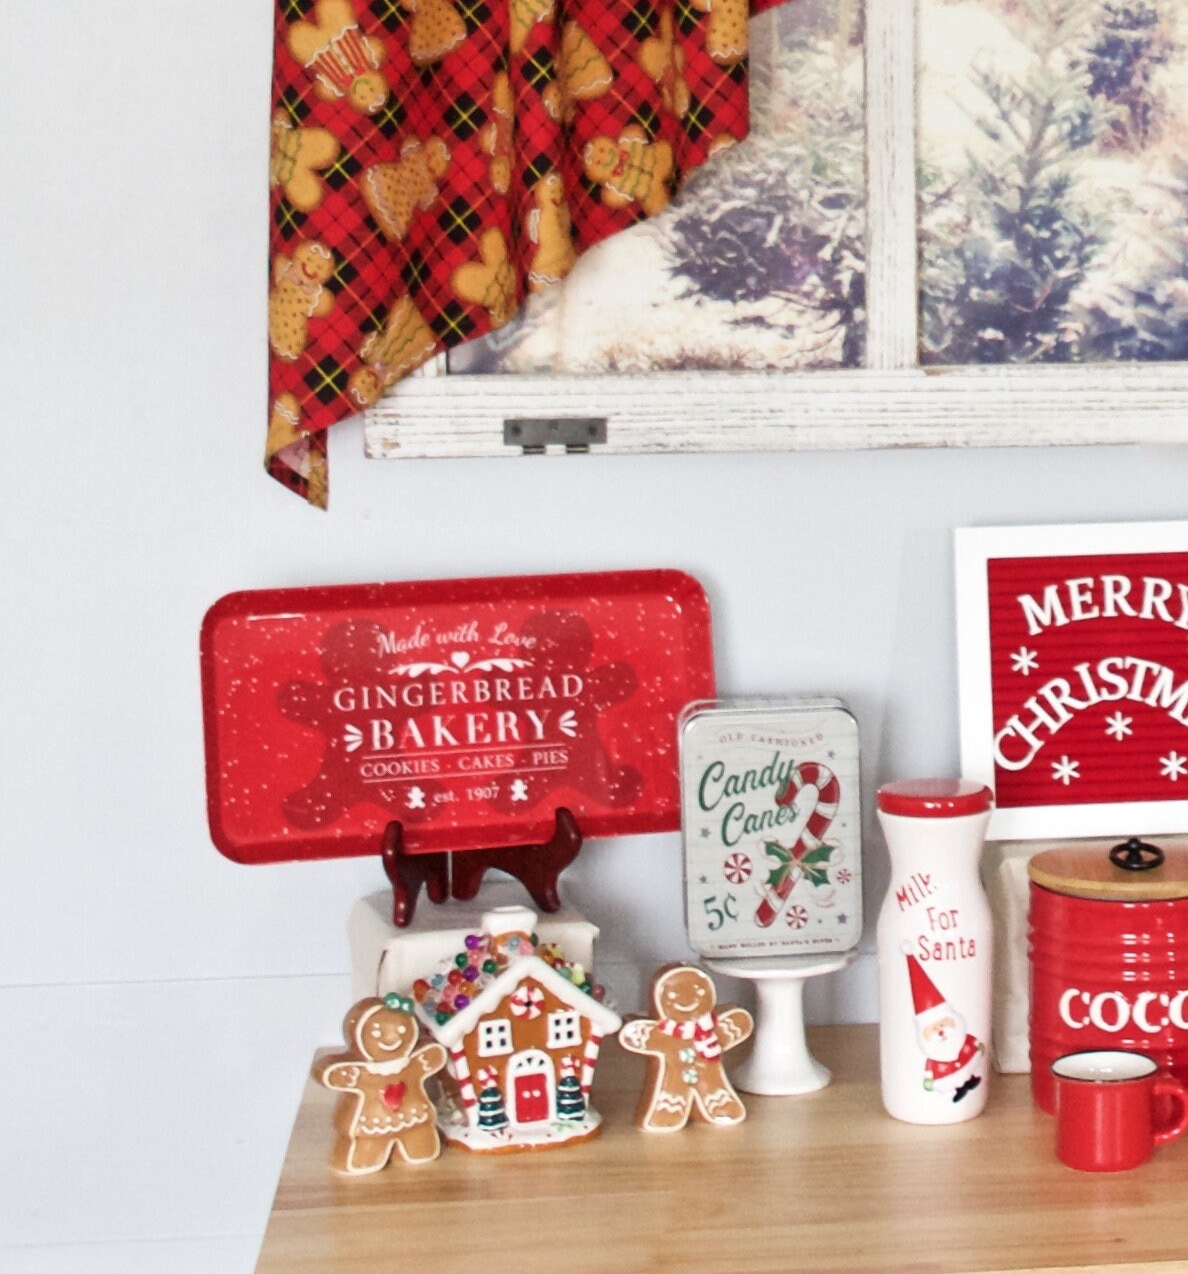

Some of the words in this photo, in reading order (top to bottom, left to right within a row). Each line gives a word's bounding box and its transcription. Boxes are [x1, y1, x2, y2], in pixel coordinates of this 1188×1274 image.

[377, 625, 429, 658] Made
[436, 620, 479, 646] with
[490, 621, 538, 650] Love
[333, 673, 584, 712] GINGERBREAD
[370, 709, 552, 751] BAKERY
[360, 758, 440, 777] COOKIES
[458, 753, 515, 772] CAKES
[532, 750, 569, 767] PIES
[698, 750, 795, 812] Candy
[721, 802, 801, 847] Canes
[895, 872, 937, 912] Milk
[927, 907, 960, 931] For
[919, 935, 977, 962] Santa
